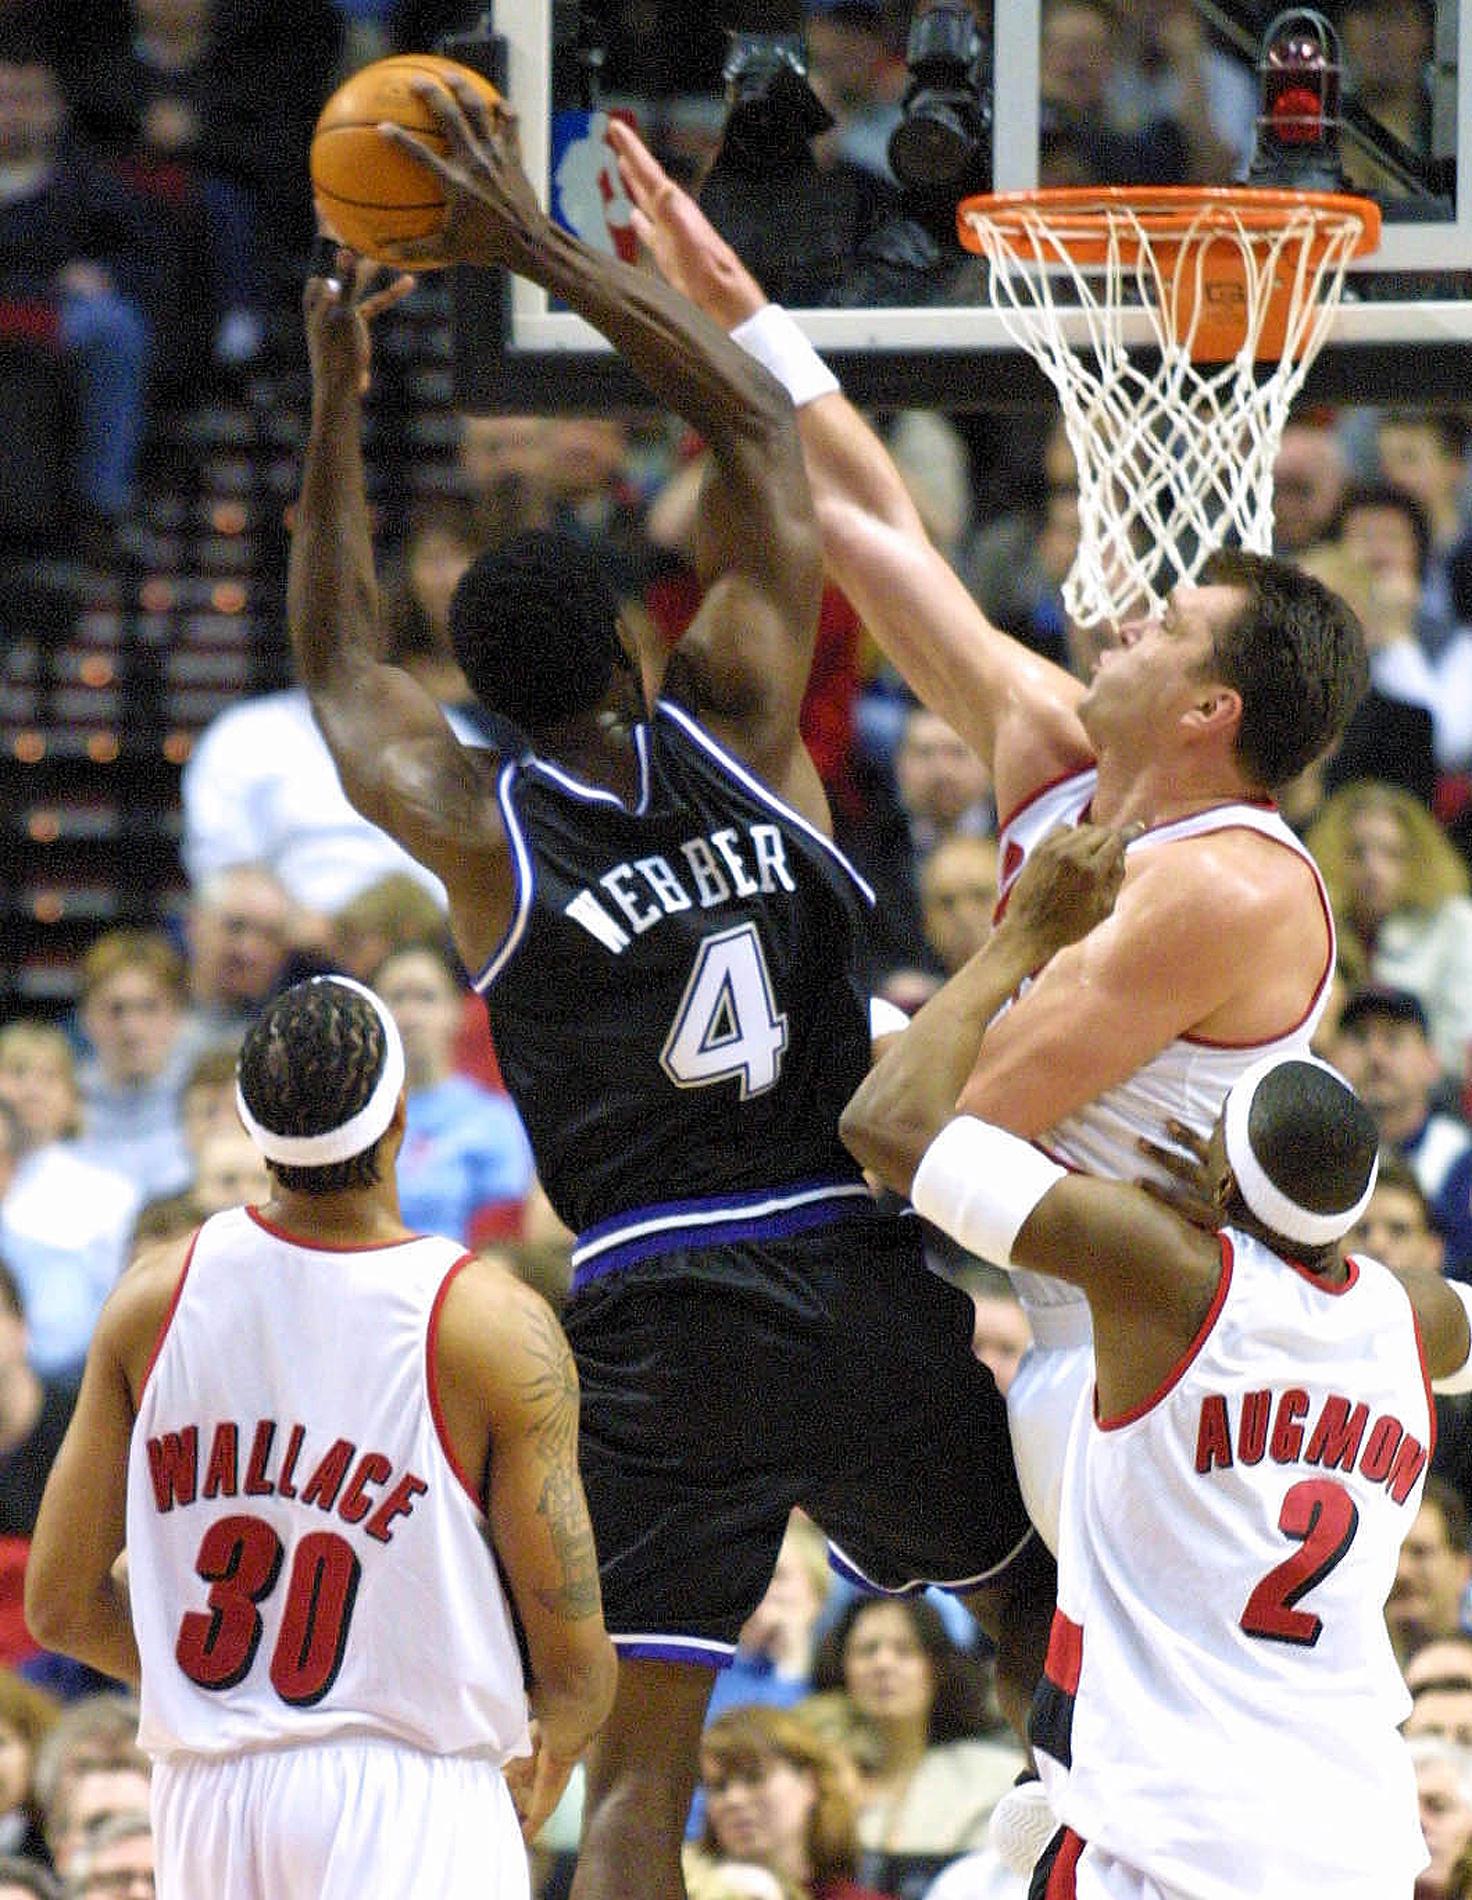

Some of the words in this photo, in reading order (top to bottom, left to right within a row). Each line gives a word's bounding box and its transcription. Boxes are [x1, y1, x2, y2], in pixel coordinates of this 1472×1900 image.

[565, 824, 796, 955] WEBBER
[659, 920, 789, 1101] 4
[146, 1420, 429, 1544] WALLACE
[1195, 1388, 1427, 1507] AUGMON
[175, 1514, 362, 1708] 30
[1239, 1477, 1360, 1647] 2
